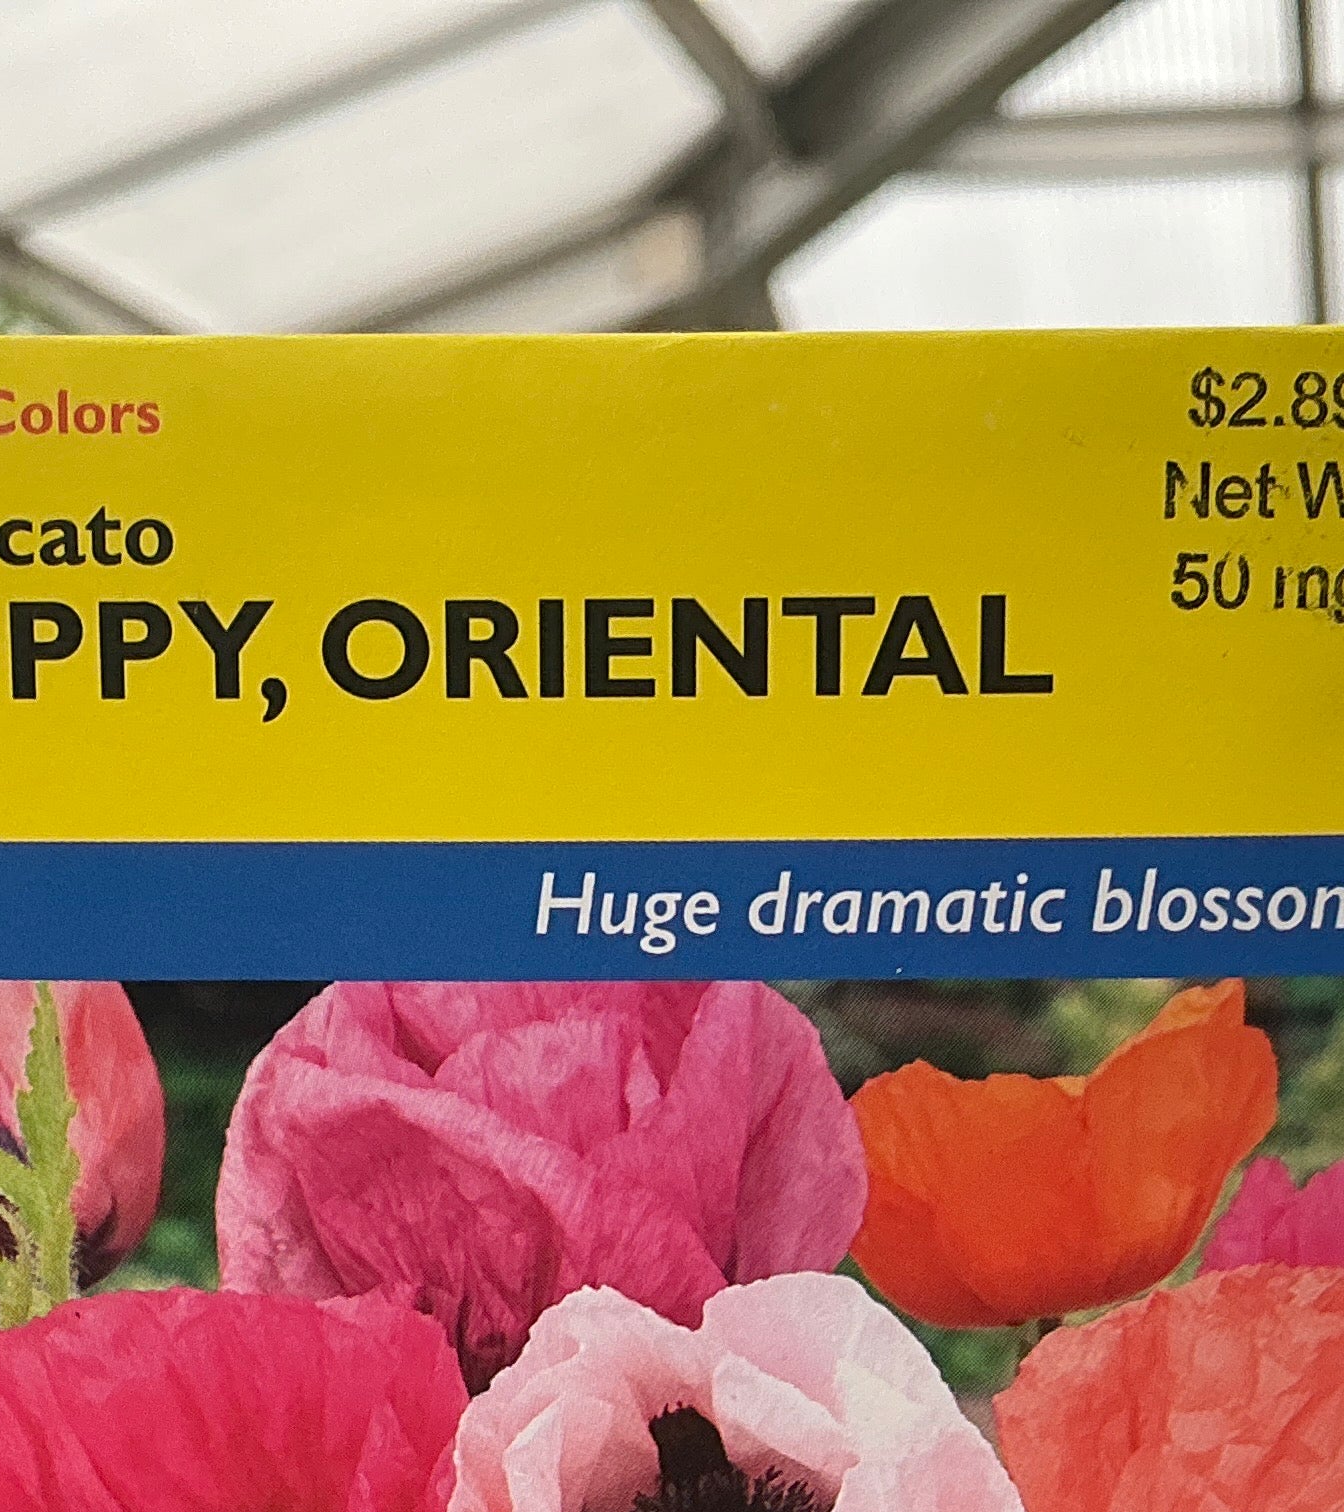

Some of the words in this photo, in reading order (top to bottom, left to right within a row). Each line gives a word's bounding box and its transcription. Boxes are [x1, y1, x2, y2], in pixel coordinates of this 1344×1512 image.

[1163, 460, 1277, 521] Net
[1172, 552, 1248, 611] 50
[322, 594, 1054, 700] ORIENTAL
[535, 872, 720, 954] Huge
[748, 873, 1066, 935] dramatic
